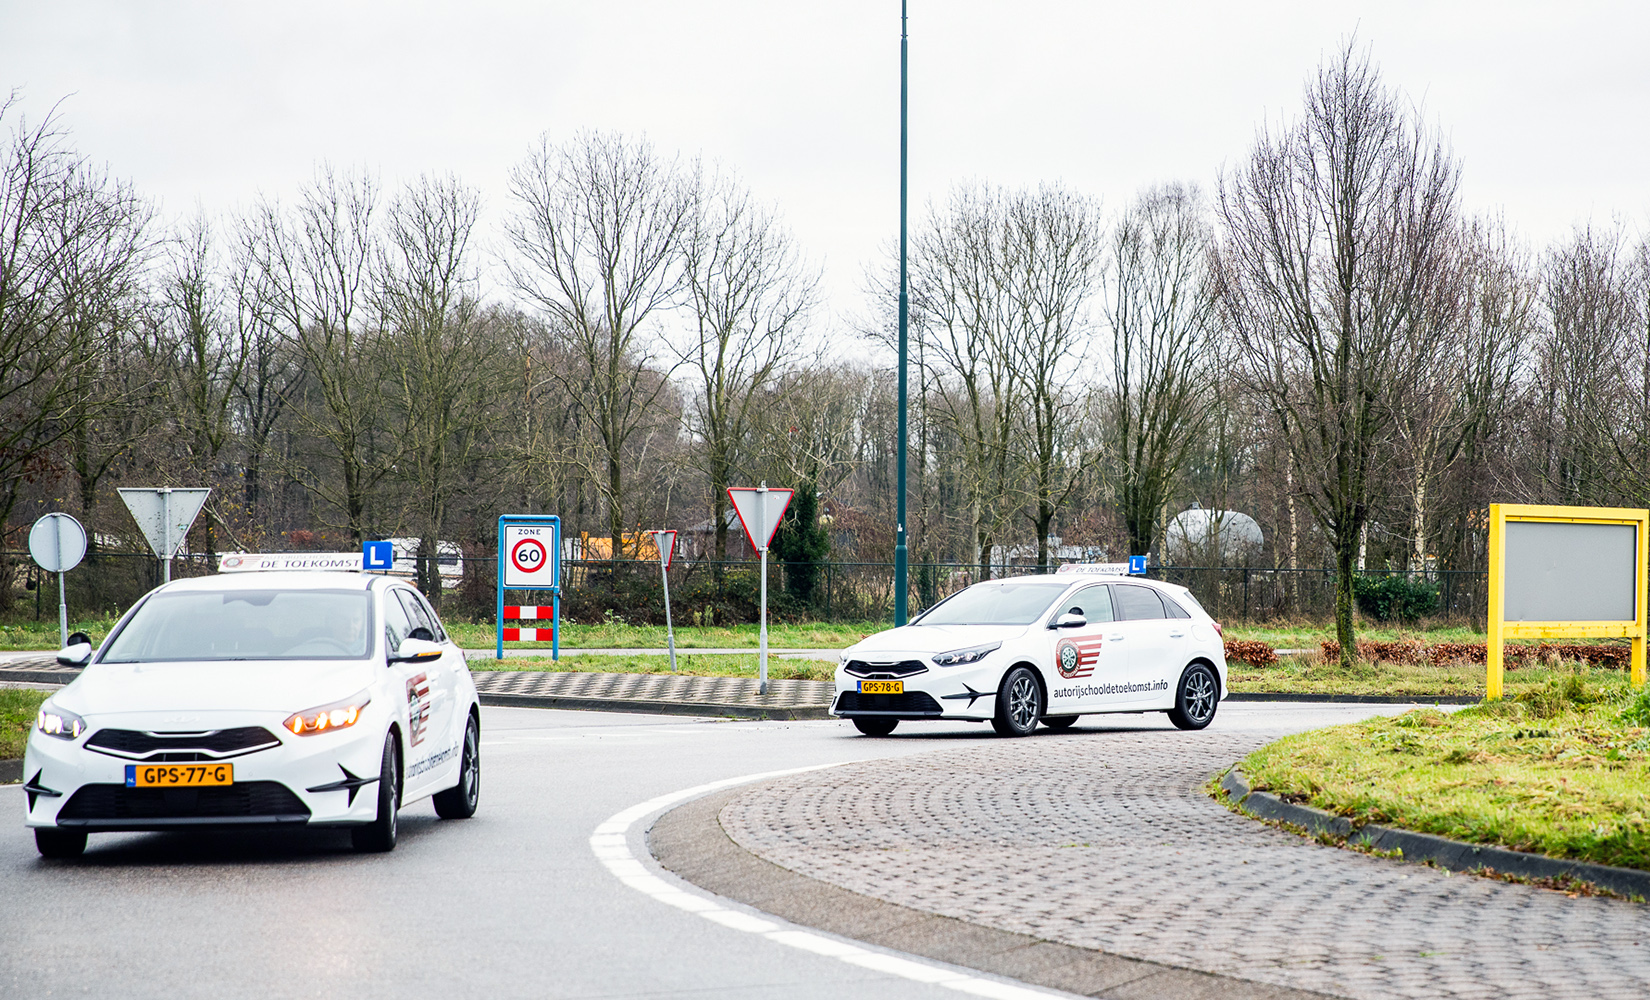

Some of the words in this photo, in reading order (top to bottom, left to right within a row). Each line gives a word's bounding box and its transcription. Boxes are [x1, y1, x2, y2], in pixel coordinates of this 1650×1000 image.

[370, 545, 385, 565] L
[518, 549, 540, 562] 60
[260, 560, 279, 568] DE
[285, 559, 361, 568] TOEKOMST
[1132, 558, 1140, 571] L
[863, 682, 900, 692] GPS-78-G
[1053, 679, 1169, 699] autorijschooldetoekomst.info
[144, 766, 226, 784] GPS-77-G
